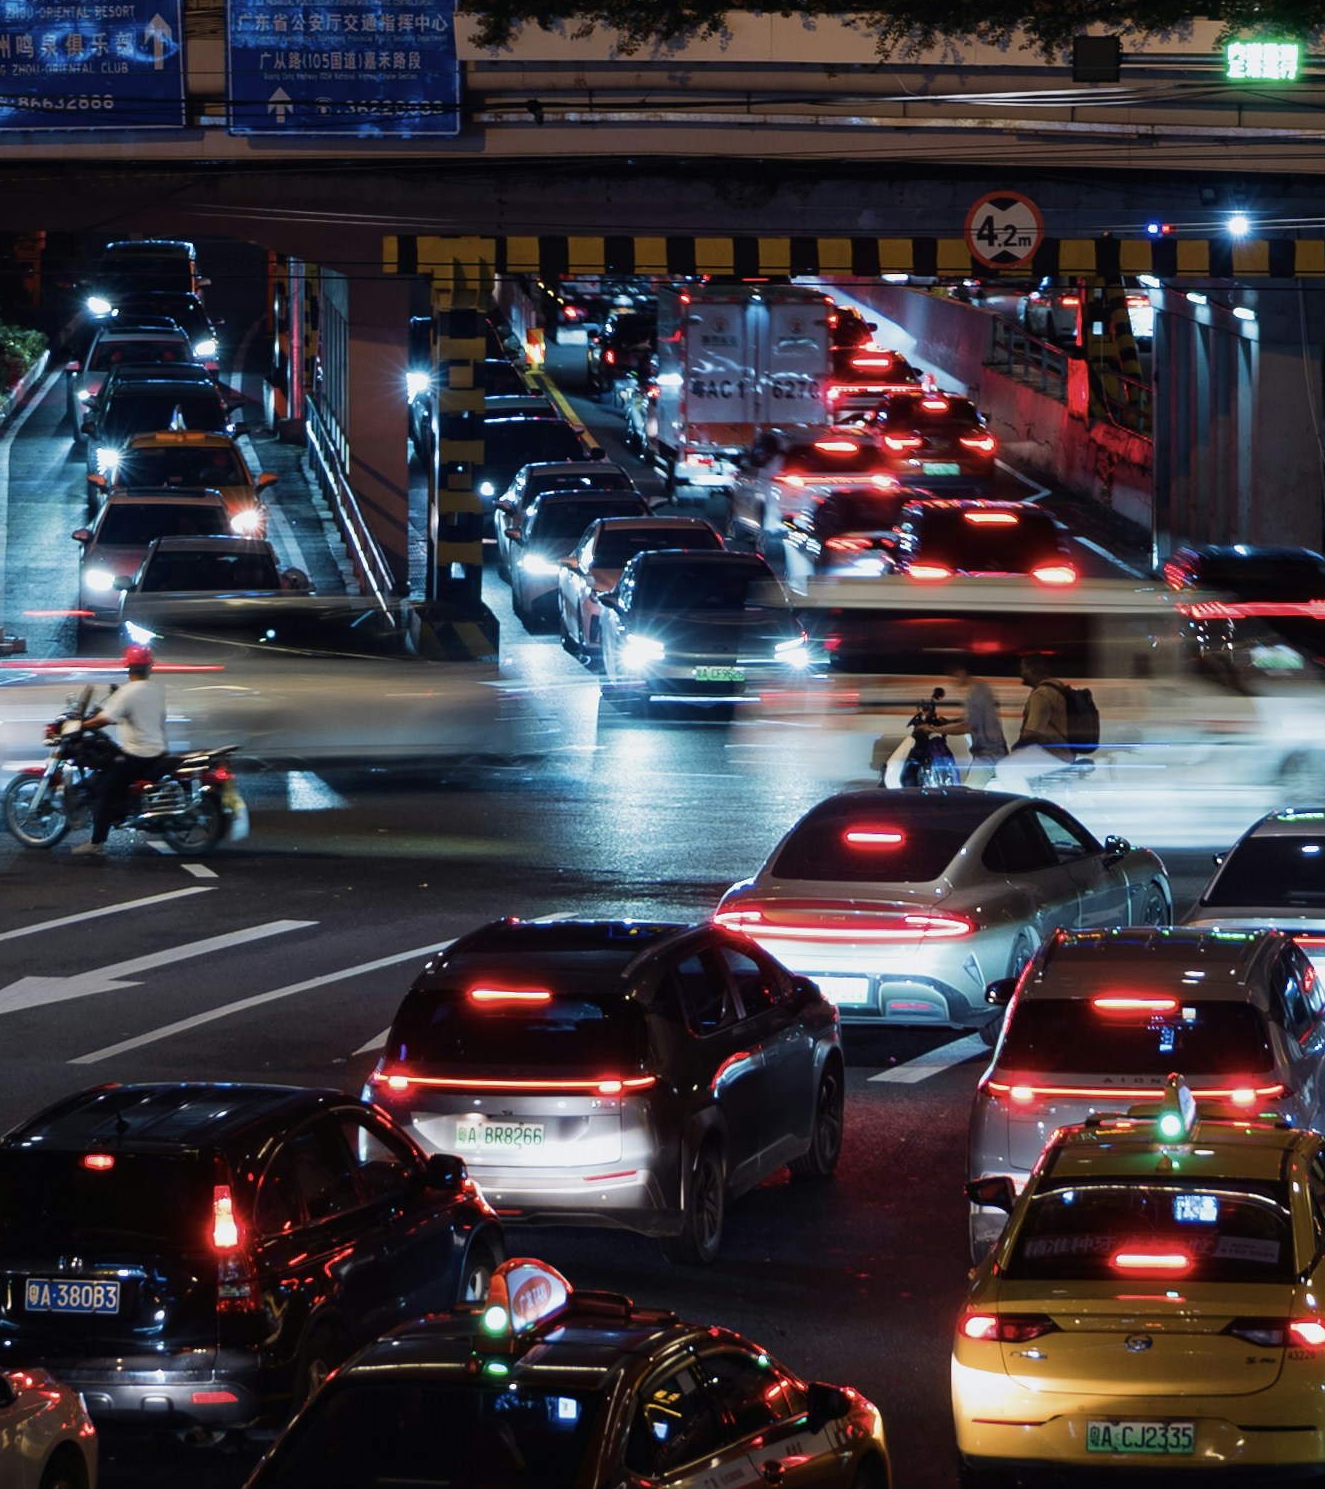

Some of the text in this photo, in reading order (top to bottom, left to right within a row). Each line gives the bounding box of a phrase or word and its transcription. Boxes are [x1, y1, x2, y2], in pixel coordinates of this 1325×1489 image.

[95, 5, 136, 18] RESORT
[237, 13, 448, 32] 广东省公安厅交通指挥中心
[101, 61, 129, 74] CLUB
[260, 51, 422, 70] 广从路(105国道)嘉禾路段
[976, 215, 1032, 248] 4.2m
[485, 1127, 543, 1145] BR8266
[1122, 1426, 1193, 1448] CJ2335
